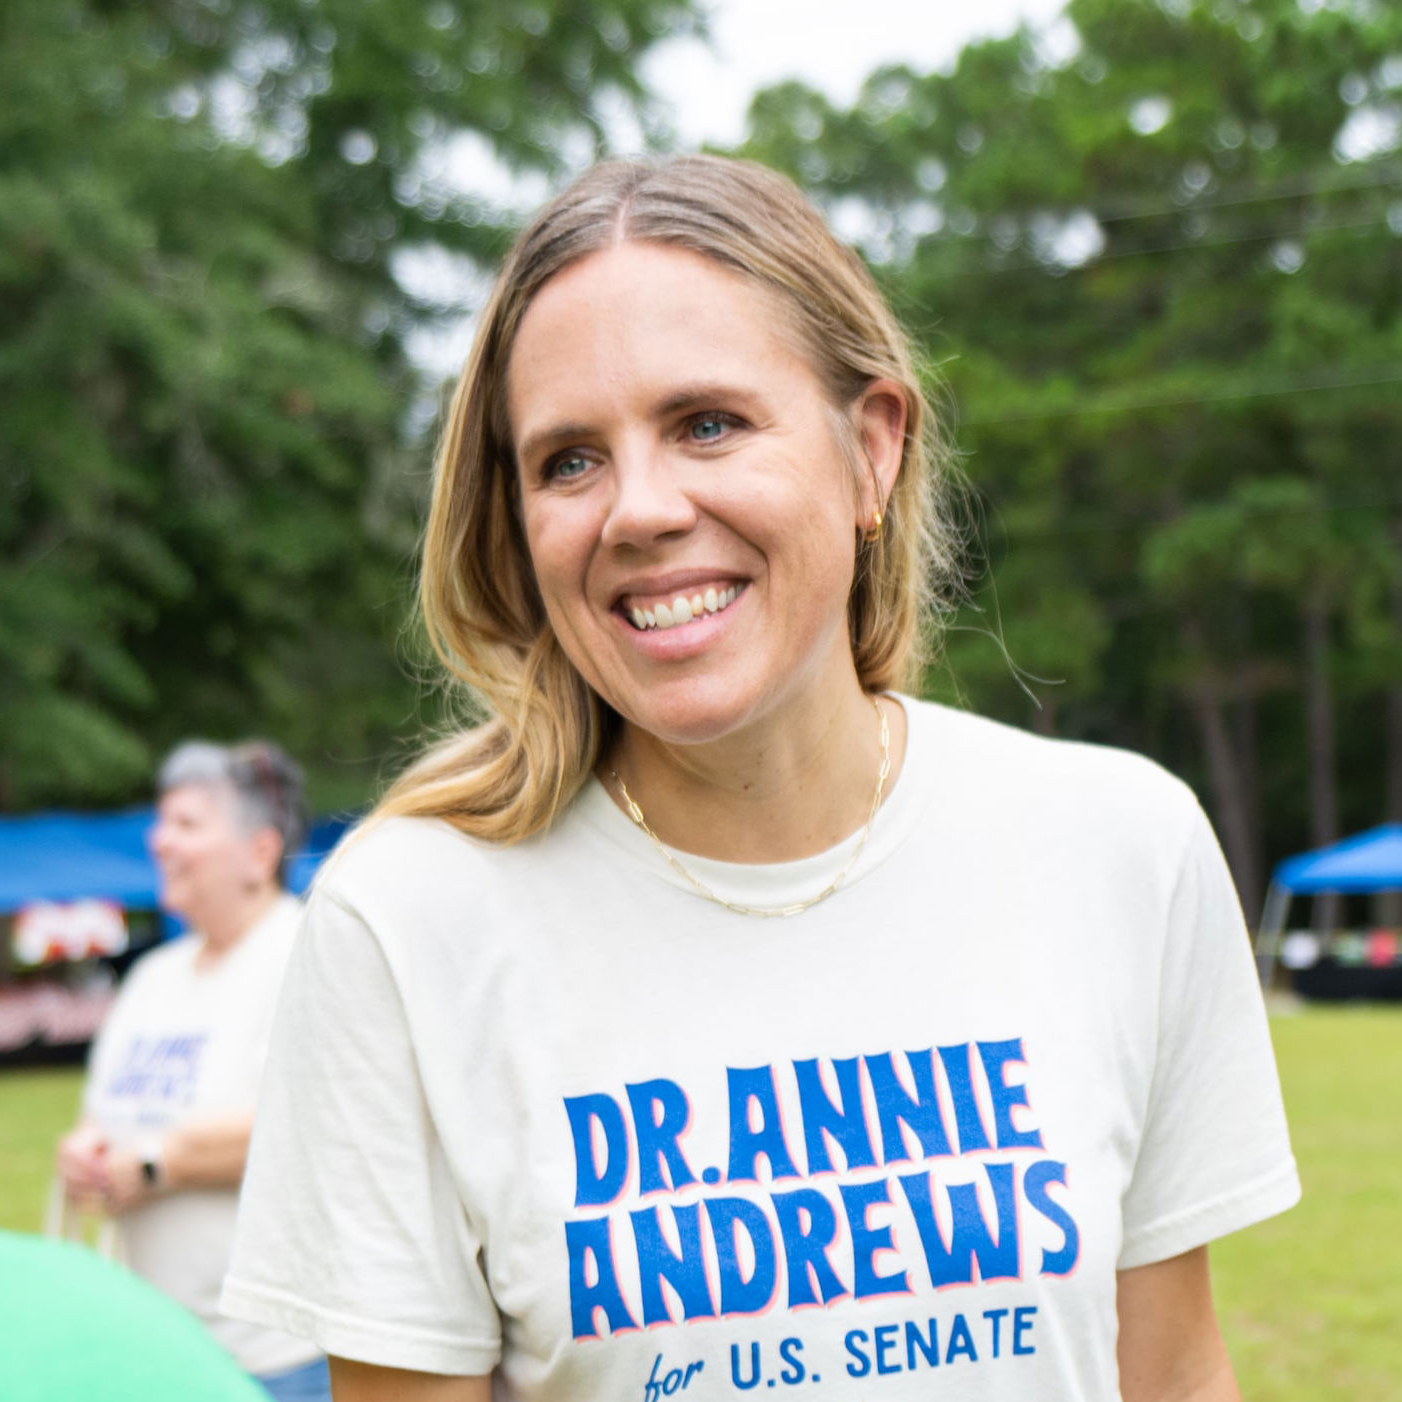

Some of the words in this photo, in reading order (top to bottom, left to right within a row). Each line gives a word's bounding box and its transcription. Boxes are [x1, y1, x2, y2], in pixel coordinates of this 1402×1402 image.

[564, 1160, 1080, 1343] ANDREWS
[730, 1337, 821, 1391] U.S.
[845, 1306, 1038, 1378] SENATE
